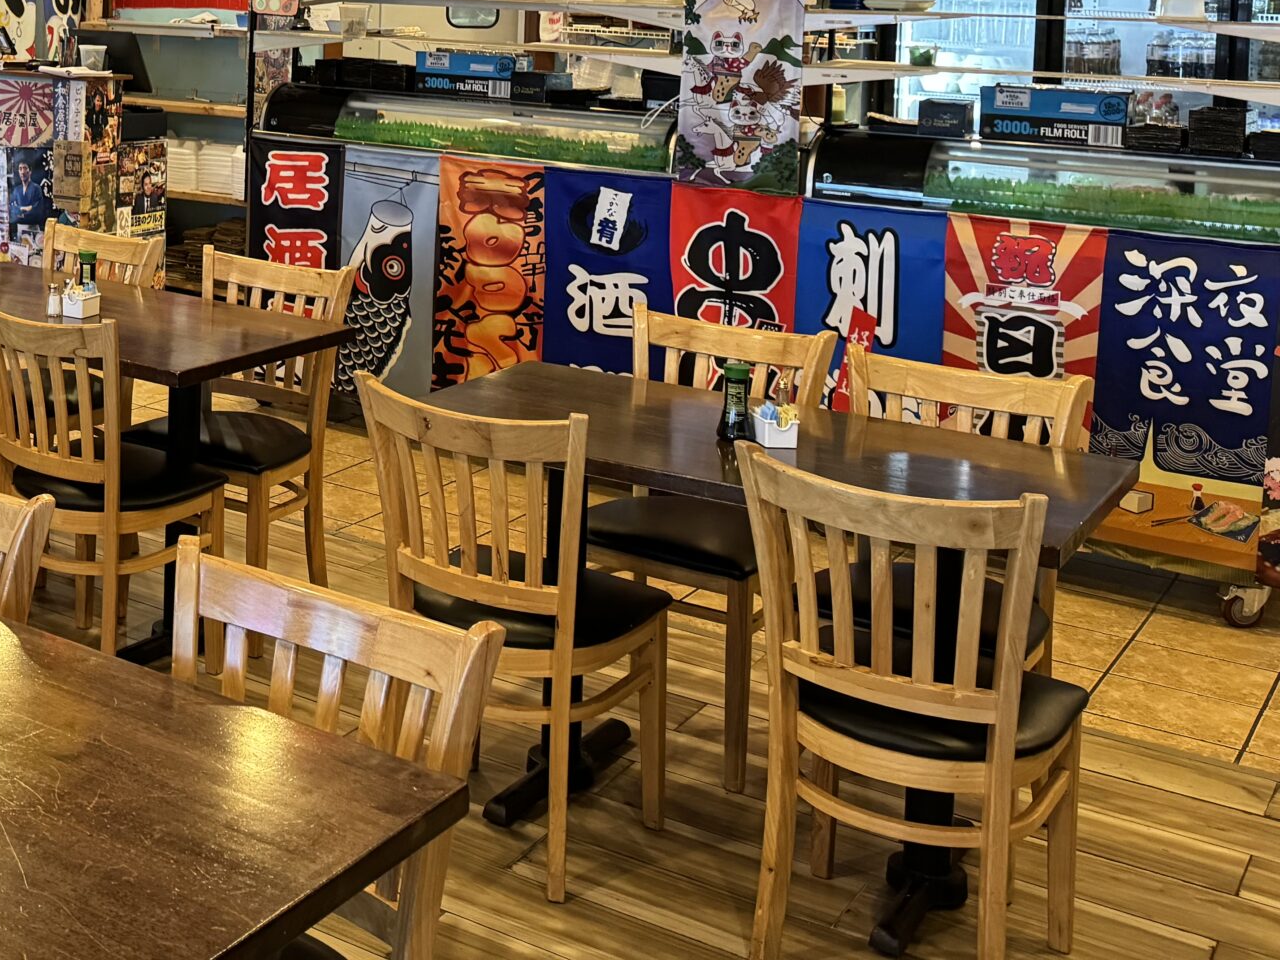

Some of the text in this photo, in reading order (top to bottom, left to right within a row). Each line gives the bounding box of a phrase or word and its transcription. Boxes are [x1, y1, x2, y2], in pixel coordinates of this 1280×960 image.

[456, 82, 488, 93] FILM ROLL
[1040, 126, 1088, 140] FILM ROLL
[1067, 123, 1088, 131] SERVICE
[565, 263, 650, 338] 酒
